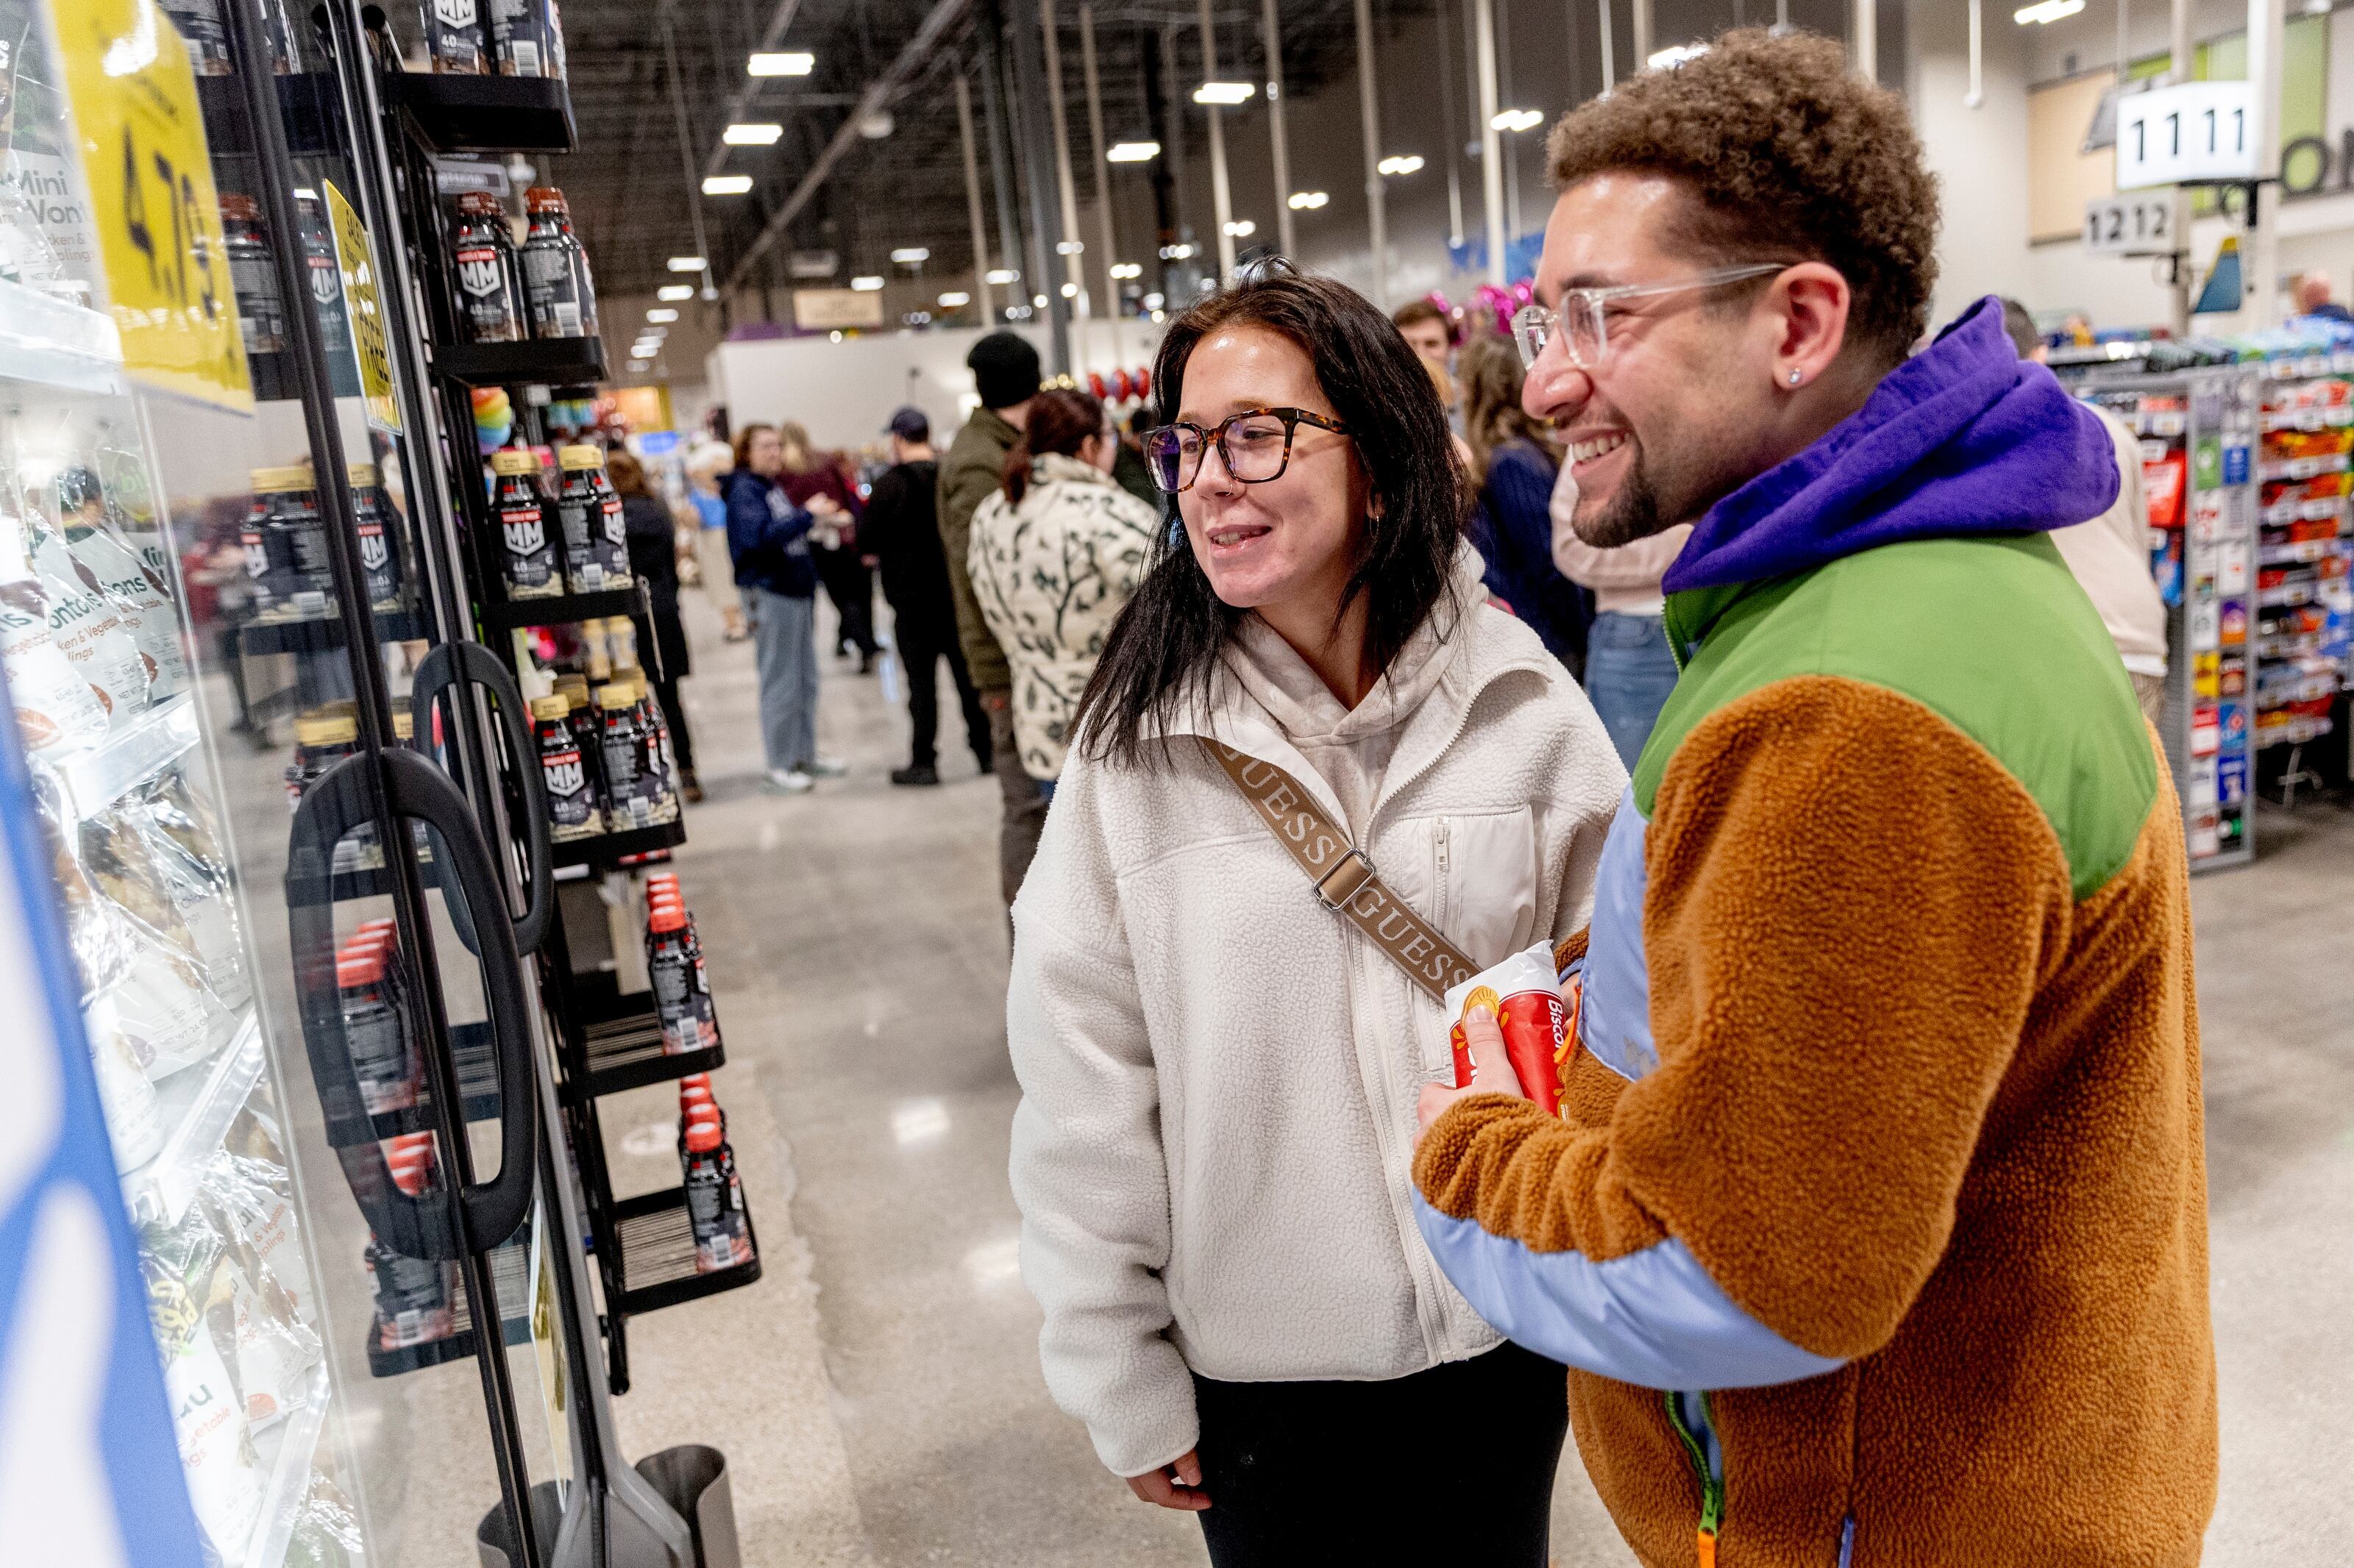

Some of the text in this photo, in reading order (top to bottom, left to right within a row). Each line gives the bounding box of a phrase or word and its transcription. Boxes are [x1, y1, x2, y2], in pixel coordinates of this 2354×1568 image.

[2130, 110, 2180, 162] 11
[2202, 107, 2244, 153] 11
[2088, 208, 2123, 242] 12
[2134, 204, 2168, 238] 12
[502, 520, 545, 557] MM
[68, 646, 93, 662] lings
[543, 760, 585, 797] MM
[1547, 999, 1566, 1049] Bisco
